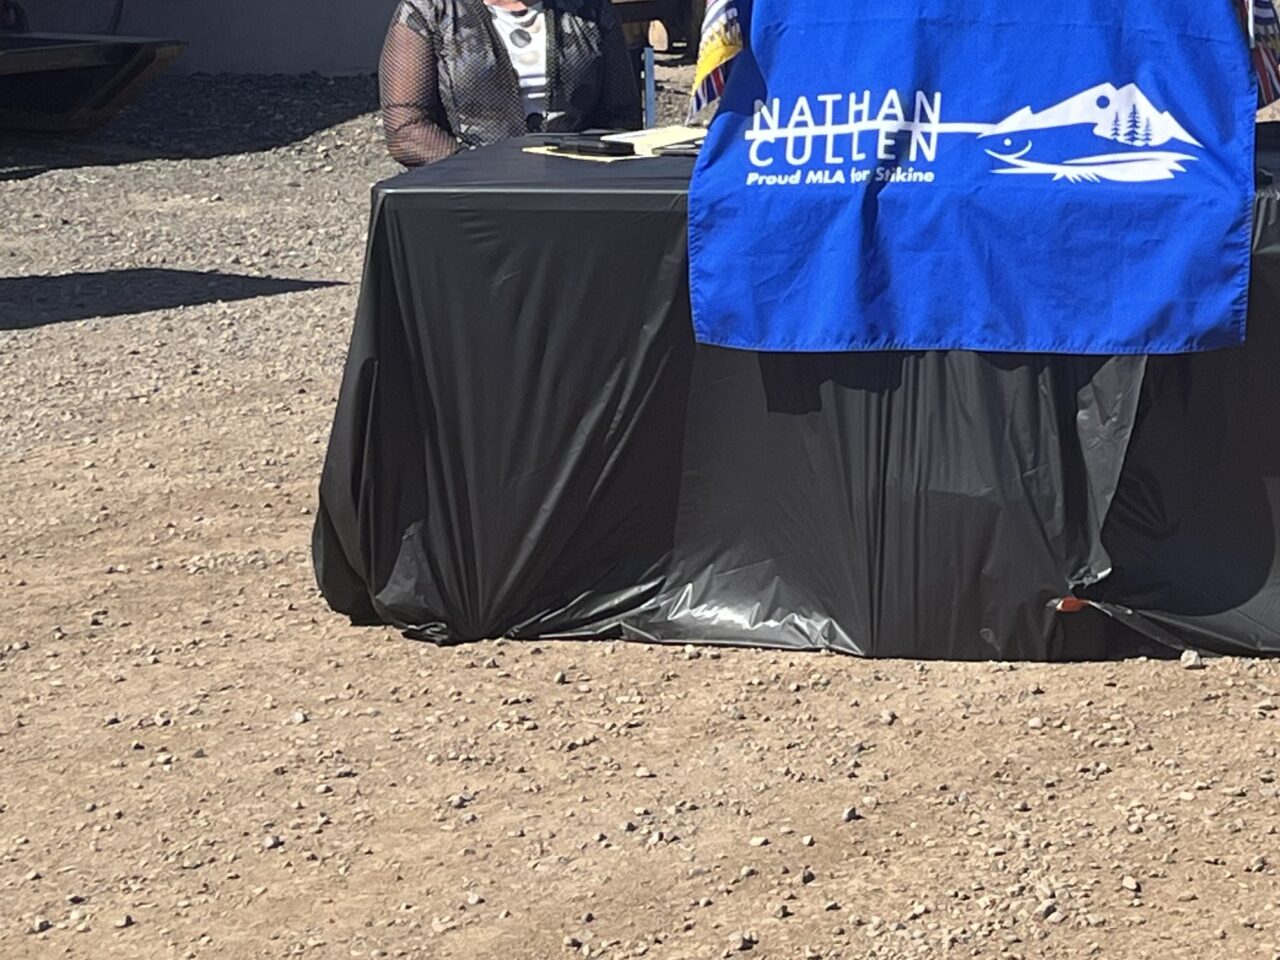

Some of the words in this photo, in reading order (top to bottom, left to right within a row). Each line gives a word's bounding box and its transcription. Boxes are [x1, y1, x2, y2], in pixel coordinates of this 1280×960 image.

[752, 88, 942, 135] NATHAN
[748, 126, 941, 167] CULLEN
[746, 170, 801, 185] Proud
[805, 170, 846, 184] MLA
[850, 166, 870, 183] for
[875, 166, 935, 183] Stikine
